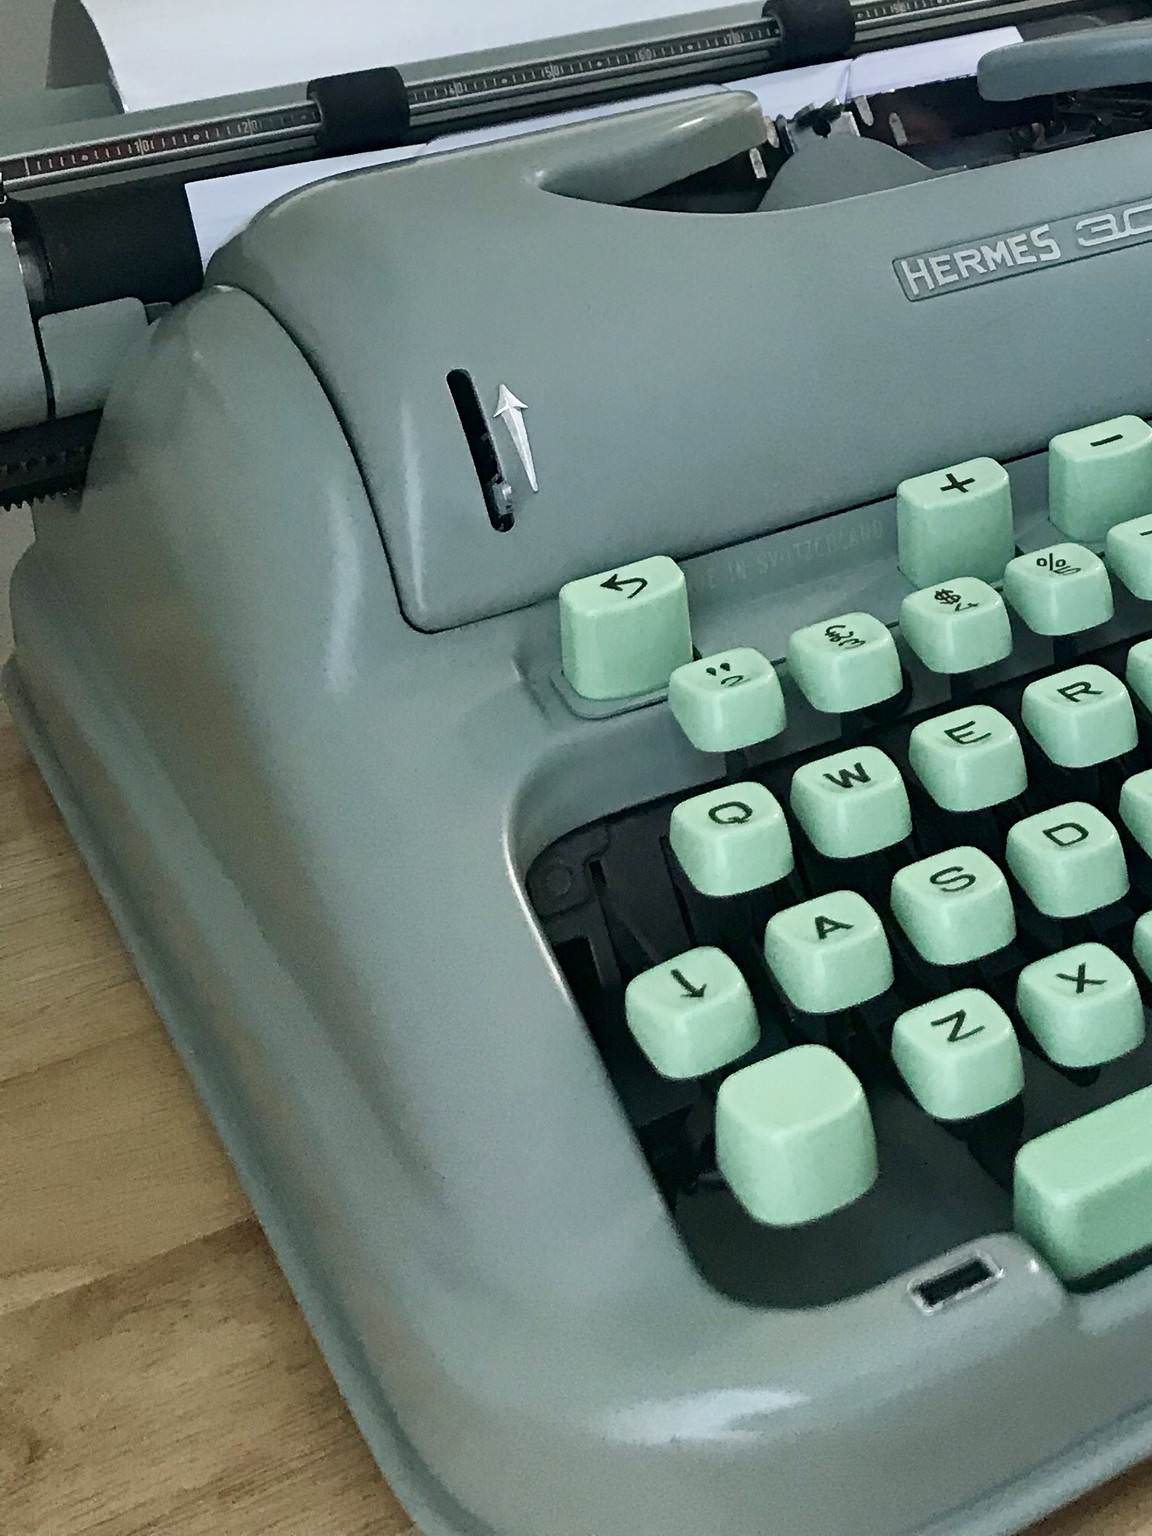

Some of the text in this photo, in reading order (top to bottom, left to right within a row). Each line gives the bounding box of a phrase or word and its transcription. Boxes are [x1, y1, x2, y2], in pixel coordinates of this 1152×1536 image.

[901, 225, 1061, 296] HERMES
[708, 802, 753, 824] Q
[823, 762, 871, 789] W
[944, 721, 991, 744] E
[1057, 682, 1103, 702] R
[815, 916, 854, 940] A
[930, 866, 976, 892] S
[1042, 823, 1089, 848] D
[931, 1009, 985, 1043] Z
[1056, 963, 1107, 994] X
